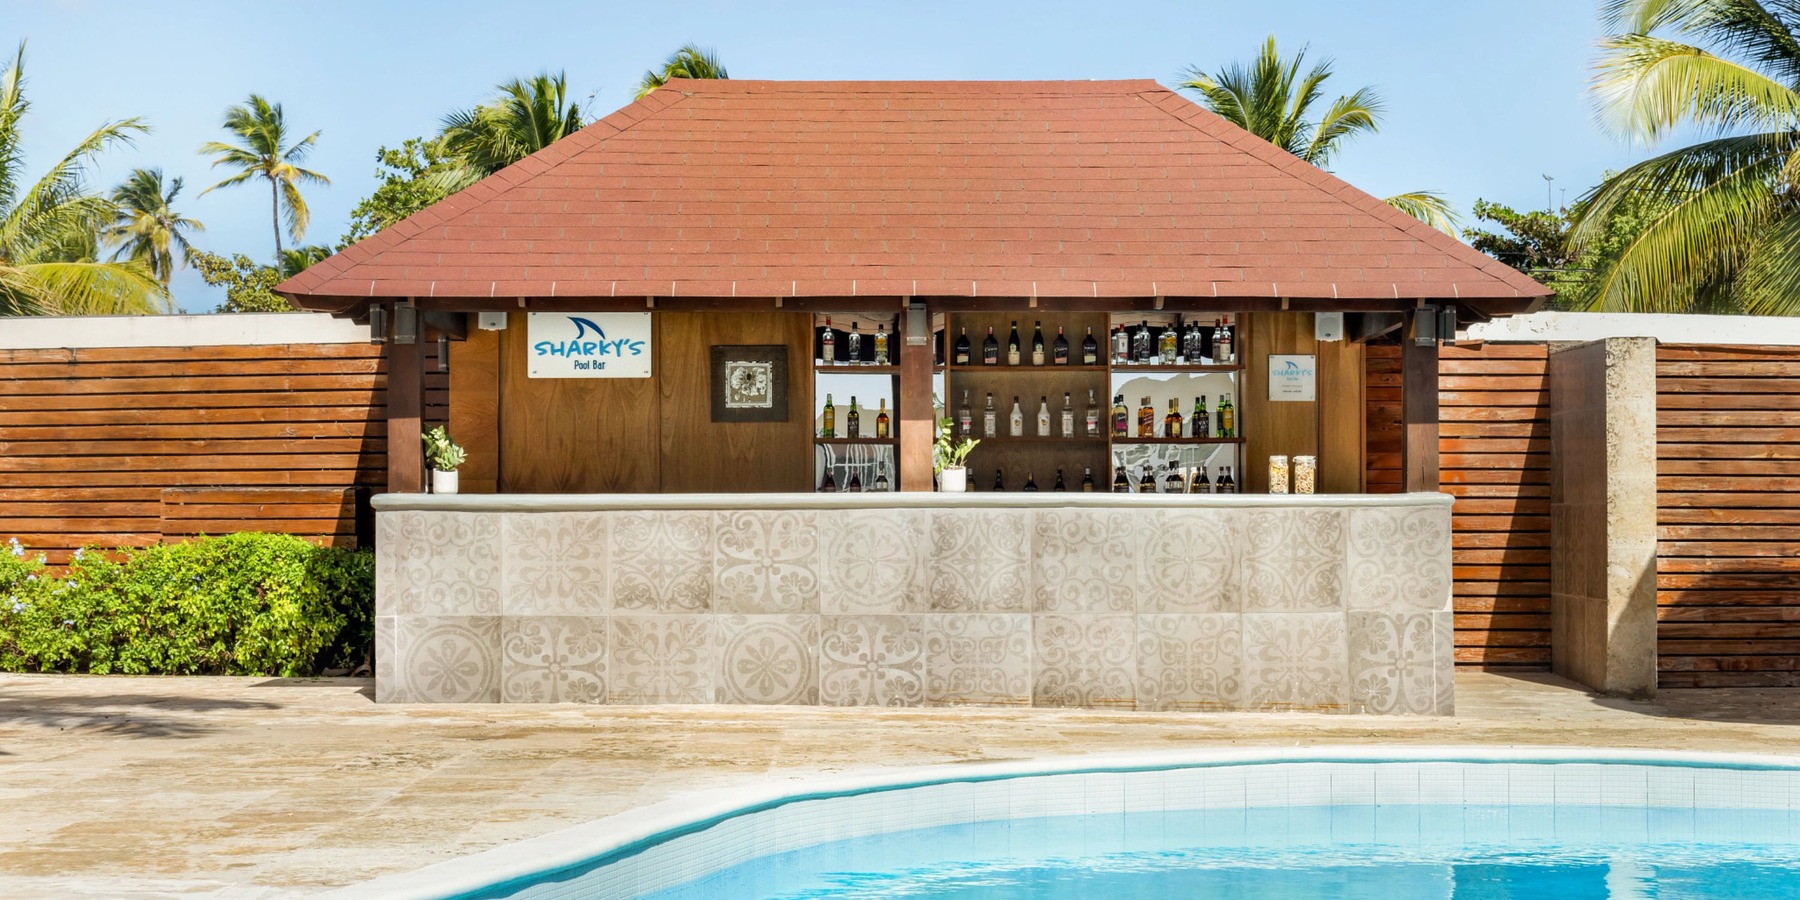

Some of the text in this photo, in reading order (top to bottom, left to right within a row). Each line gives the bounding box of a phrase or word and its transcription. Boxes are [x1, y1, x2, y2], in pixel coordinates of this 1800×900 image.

[534, 338, 646, 358] SHARKY'S
[574, 360, 606, 370] Pool Bar
